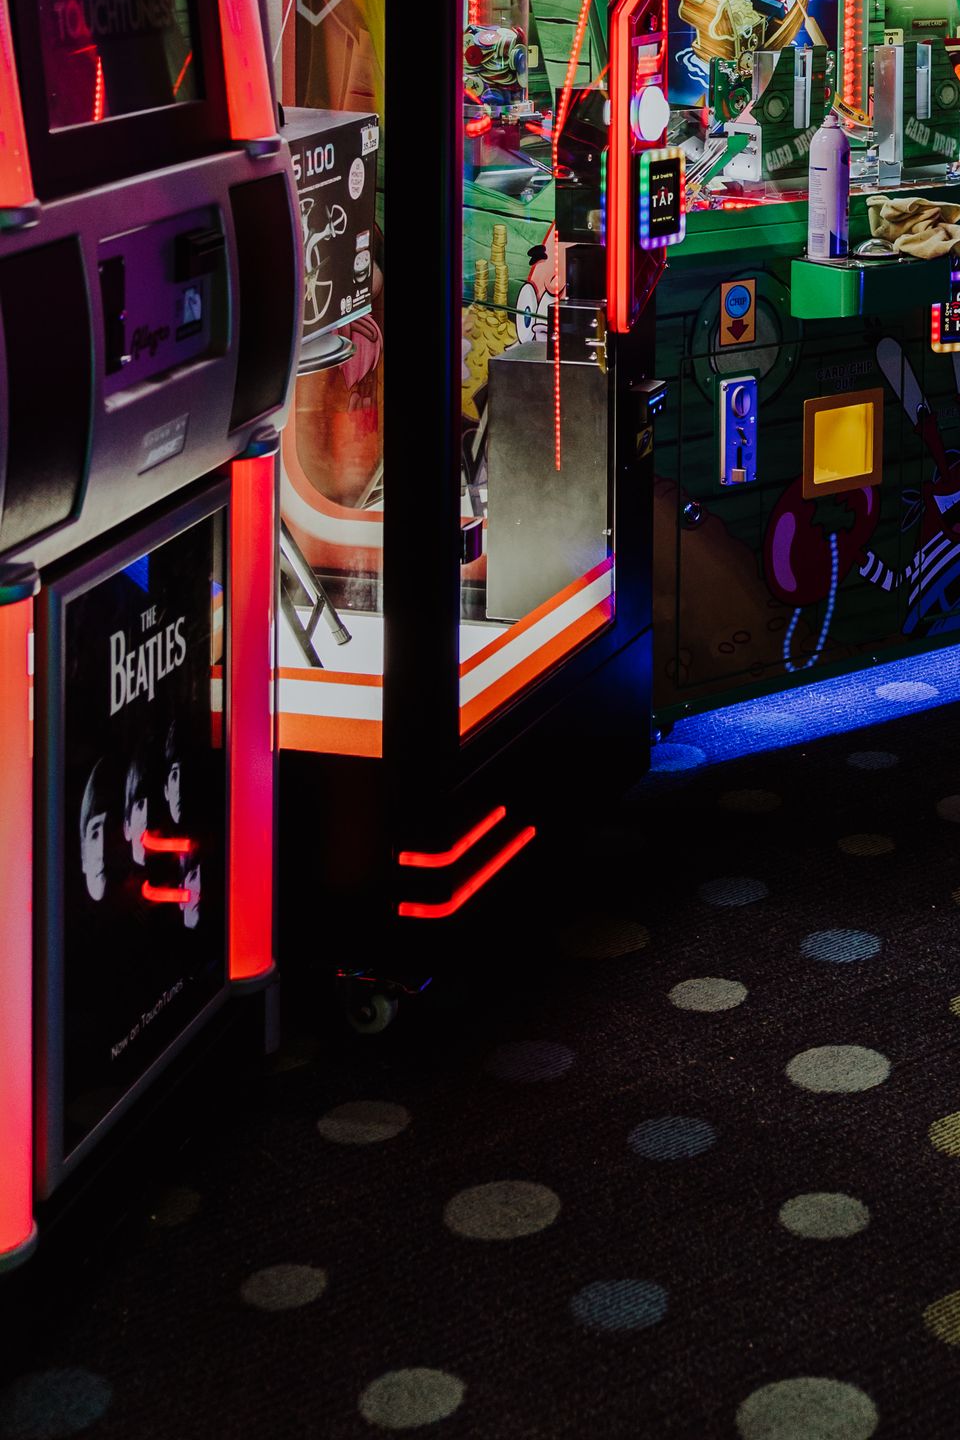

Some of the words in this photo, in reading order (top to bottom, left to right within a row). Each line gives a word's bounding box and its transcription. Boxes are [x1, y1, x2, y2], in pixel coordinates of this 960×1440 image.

[904, 116, 931, 148] CARD
[932, 131, 958, 162] DROP
[306, 143, 336, 177] 100
[765, 143, 795, 172] CARD
[652, 191, 674, 208] TAP
[729, 296, 748, 307] CHIP
[140, 604, 157, 633] THE
[109, 615, 187, 717] BEATLES
